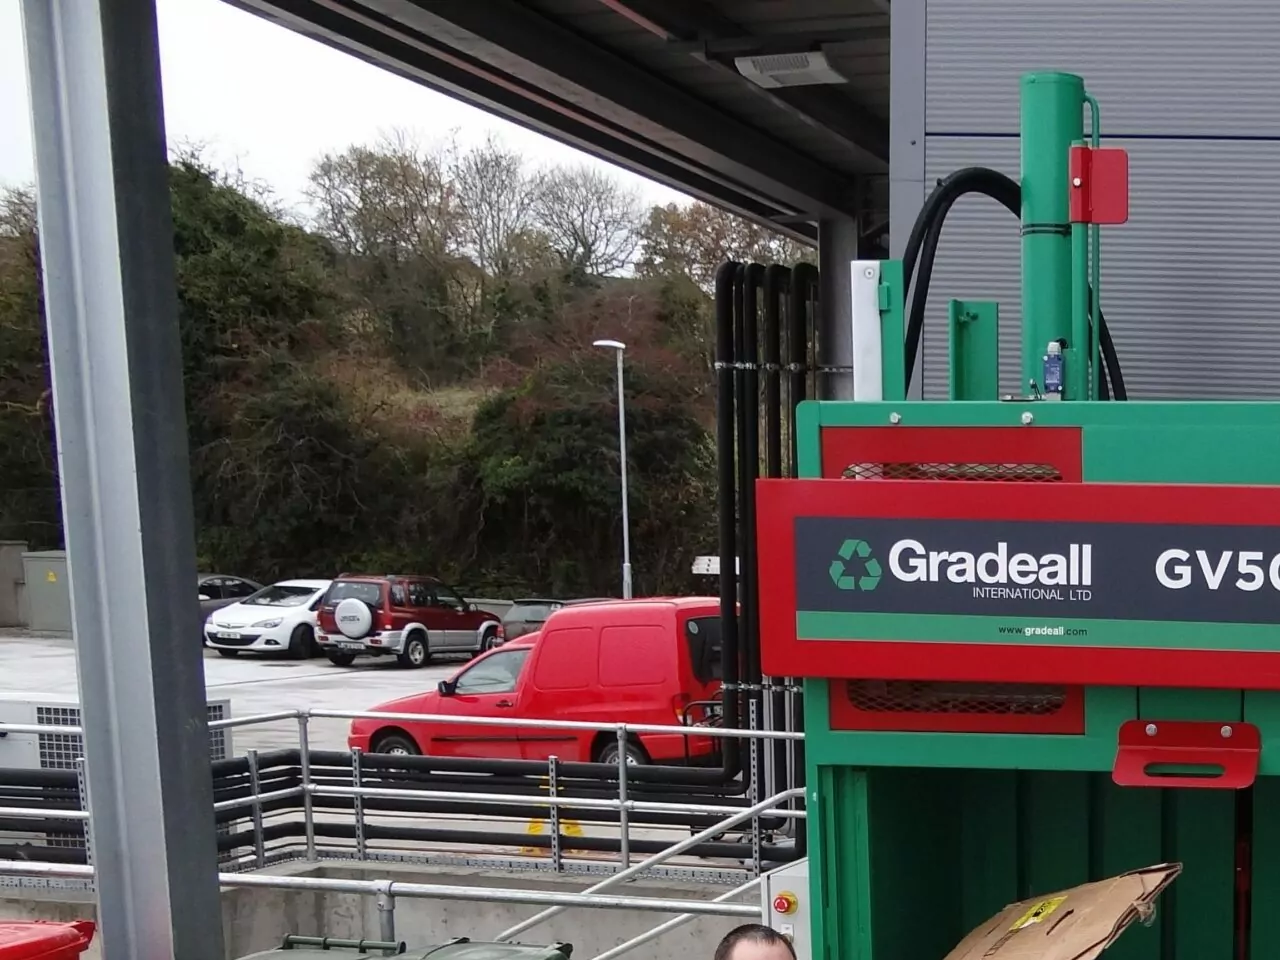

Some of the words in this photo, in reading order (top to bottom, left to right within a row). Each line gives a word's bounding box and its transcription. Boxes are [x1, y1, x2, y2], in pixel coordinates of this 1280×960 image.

[888, 538, 1092, 586] Gradeall
[973, 587, 1065, 601] INTERNATIONAL
[1069, 589, 1092, 601] LTD
[998, 625, 1088, 637] www.gradeall.com
